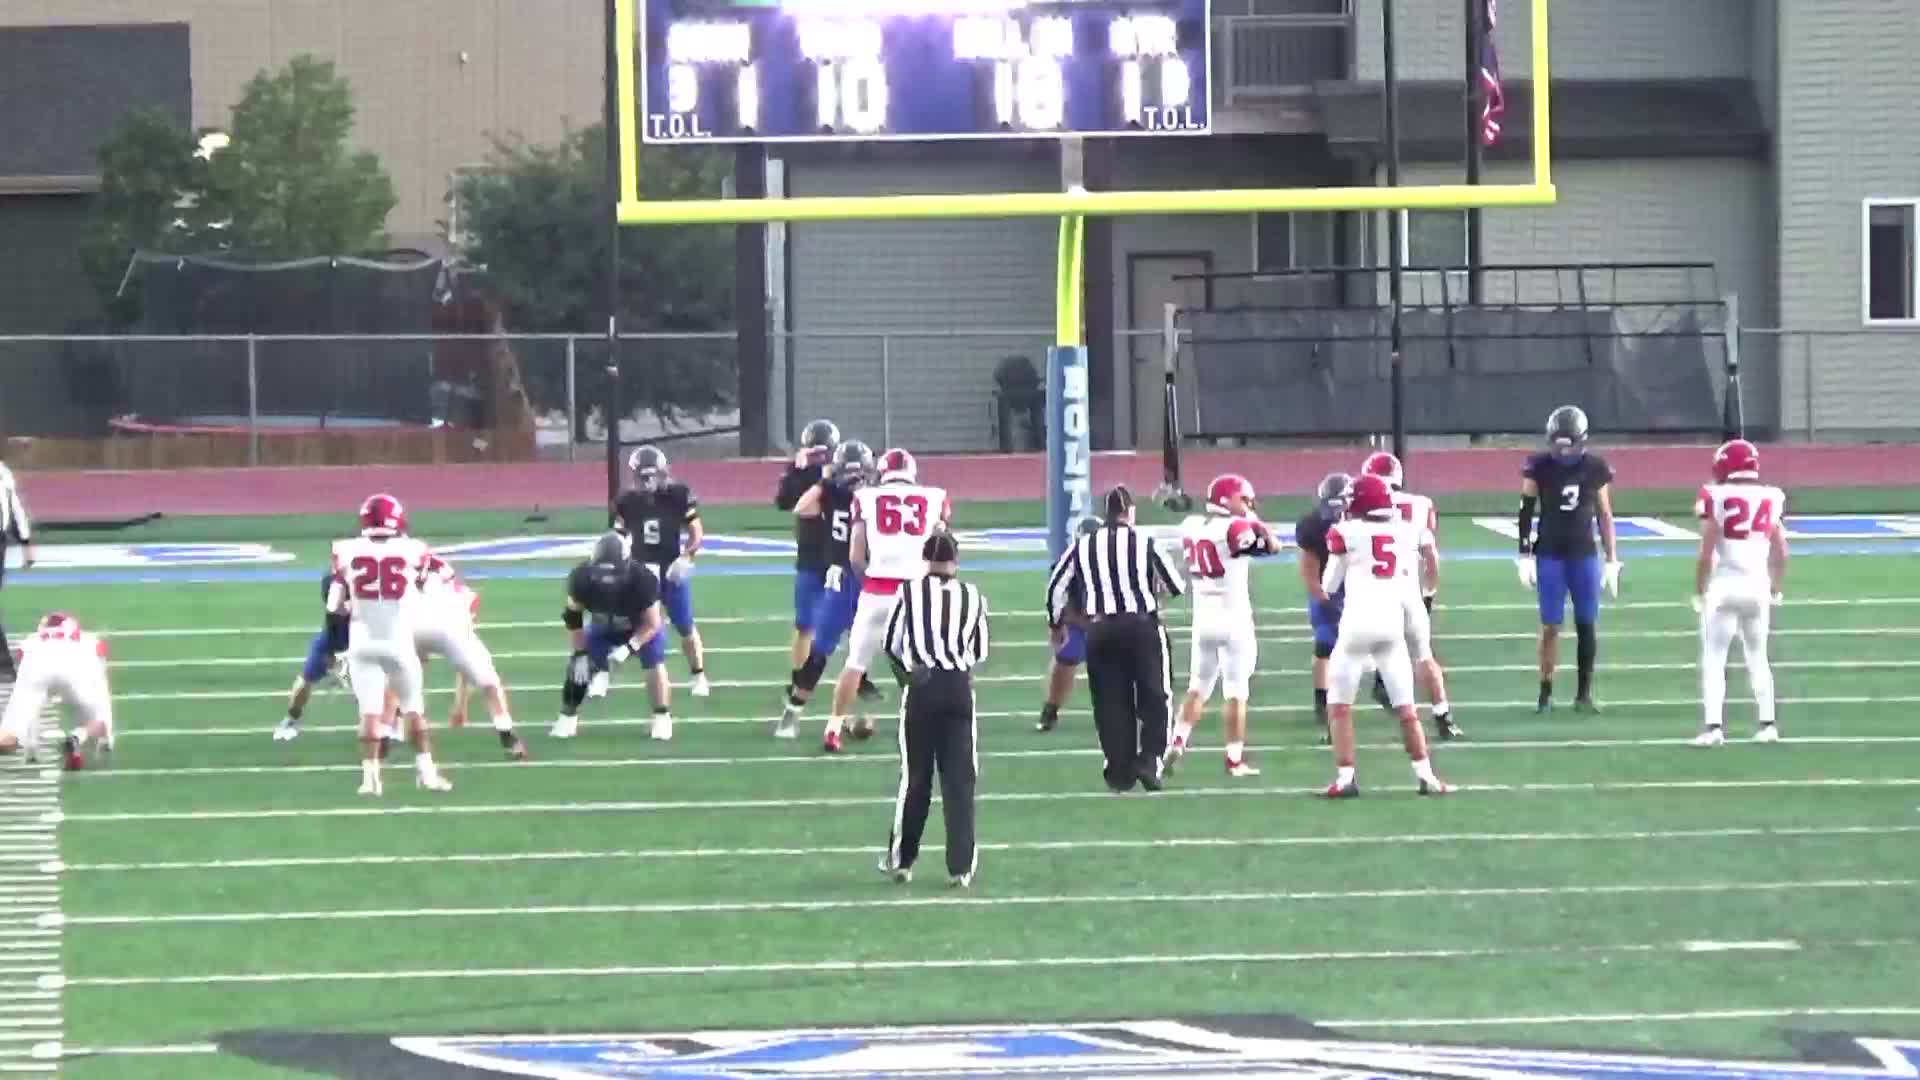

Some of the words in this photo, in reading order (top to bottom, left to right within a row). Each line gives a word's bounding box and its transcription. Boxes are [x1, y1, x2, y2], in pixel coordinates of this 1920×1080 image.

[817, 58, 887, 132] 10
[650, 113, 711, 137] T.O.L.
[1143, 106, 1207, 130] T.O.L.
[876, 495, 928, 536] 63
[1560, 484, 1580, 511] 3
[832, 510, 849, 542] 5
[1723, 497, 1774, 540] 24
[1183, 537, 1225, 578] 20
[1371, 535, 1396, 578] 5
[352, 556, 406, 600] 26
